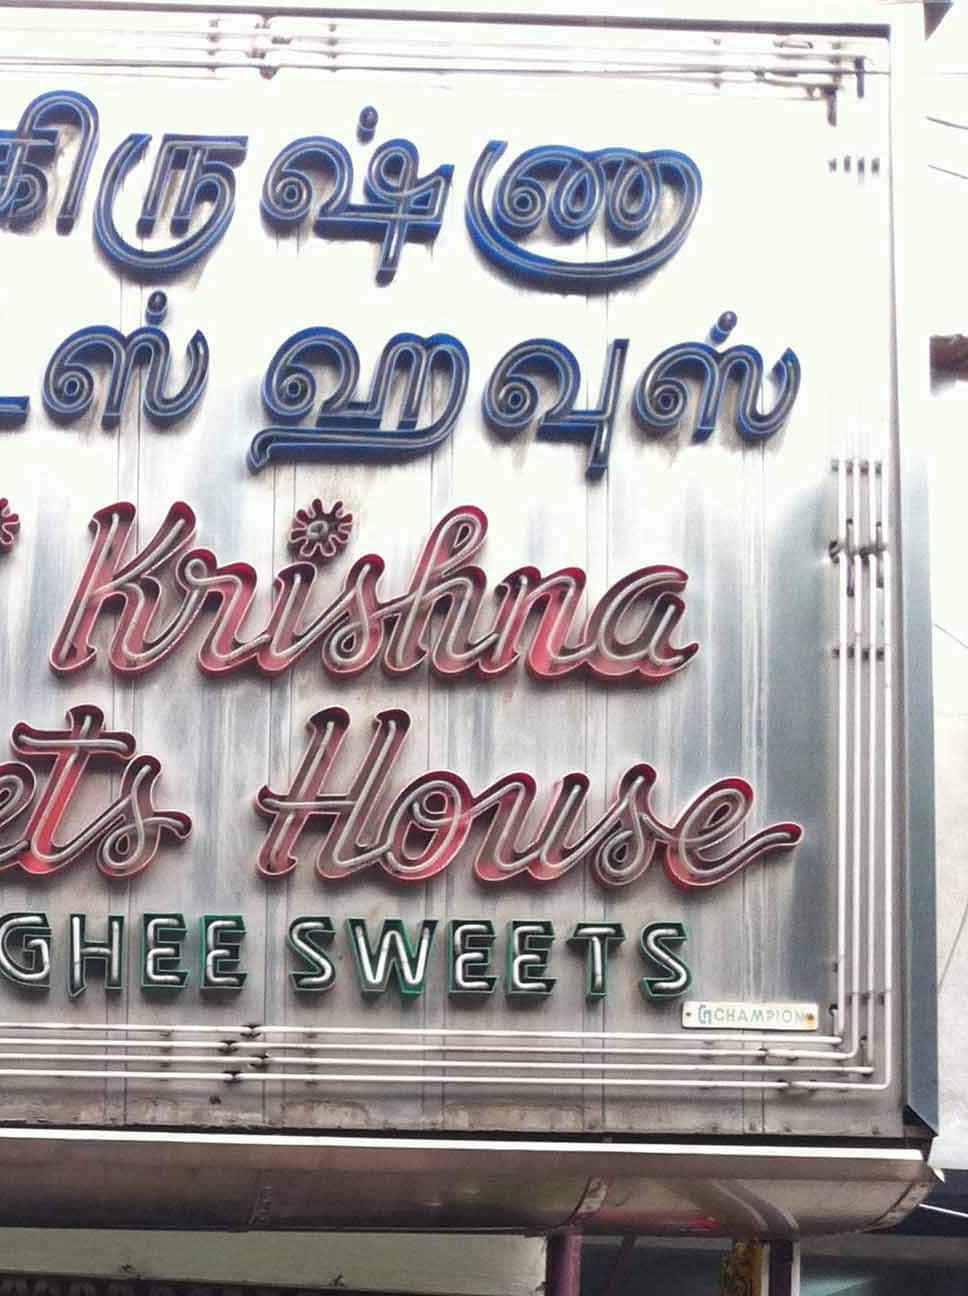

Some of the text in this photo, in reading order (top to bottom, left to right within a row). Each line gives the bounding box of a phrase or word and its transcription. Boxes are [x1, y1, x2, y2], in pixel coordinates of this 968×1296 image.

[246, 310, 801, 477] ஹவுஸ்
[48, 496, 700, 683] Krishna
[254, 706, 804, 888] House
[287, 915, 692, 1000] SWEETS
